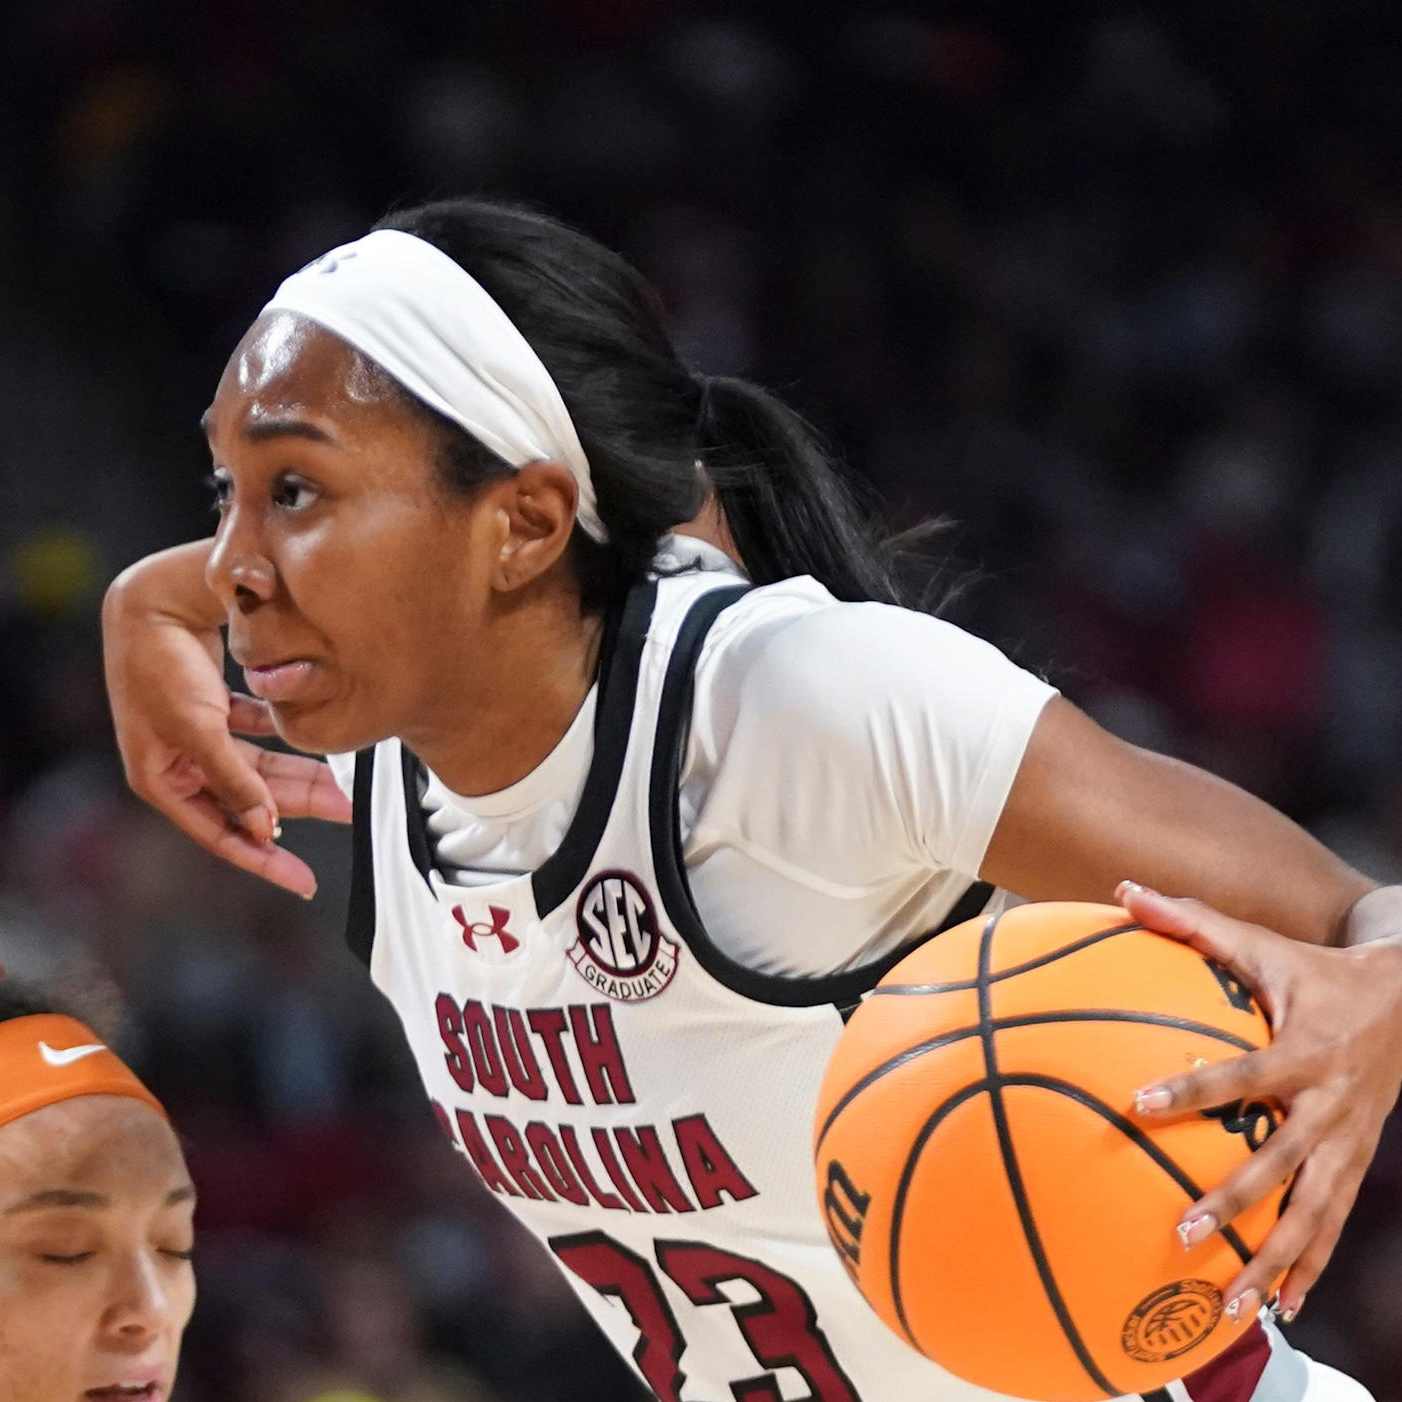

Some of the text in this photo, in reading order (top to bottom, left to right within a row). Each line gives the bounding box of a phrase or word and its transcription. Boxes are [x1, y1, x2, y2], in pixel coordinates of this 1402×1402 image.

[582, 879, 651, 970] SEC
[584, 960, 670, 998] GRADUATE
[435, 992, 637, 1105] SOUTH
